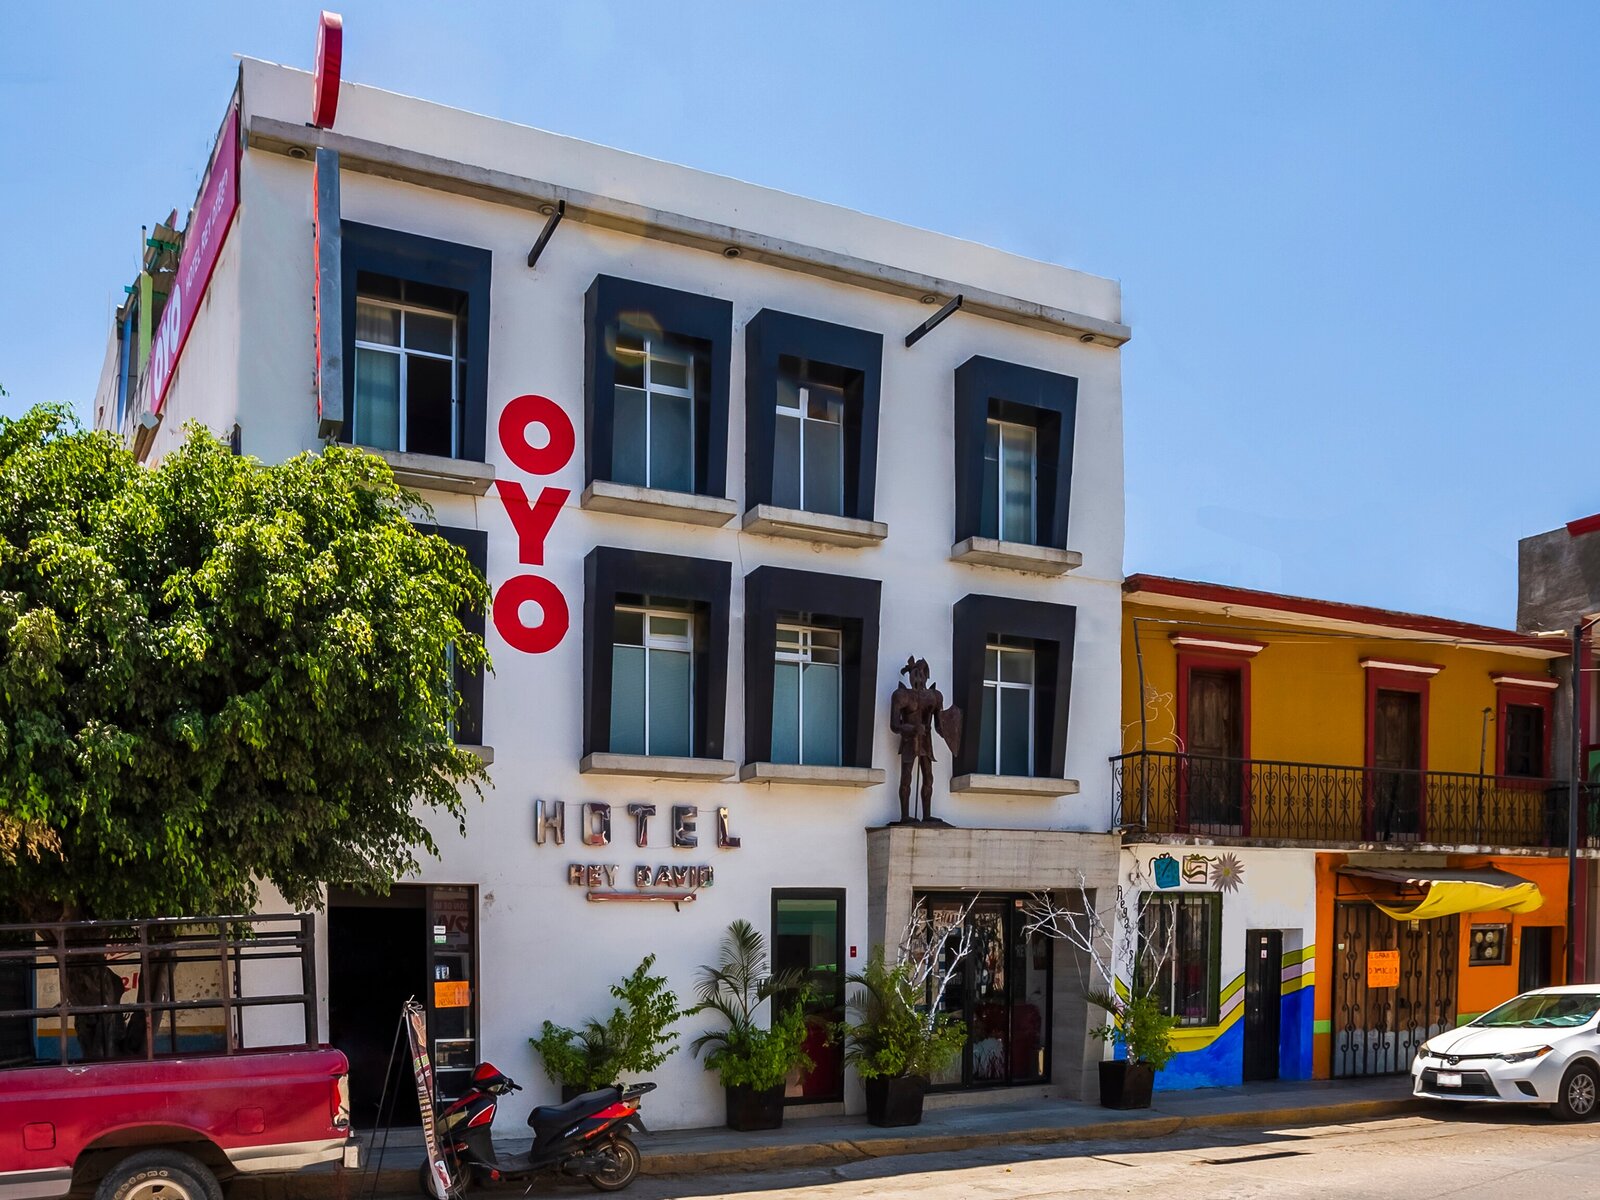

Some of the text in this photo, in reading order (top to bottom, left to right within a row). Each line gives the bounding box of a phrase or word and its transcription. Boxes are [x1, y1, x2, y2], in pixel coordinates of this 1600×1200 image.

[154, 283, 182, 402] OYO
[493, 395, 576, 654] OYO
[535, 799, 742, 849] HOTEL
[568, 863, 715, 888] REY DAVID
